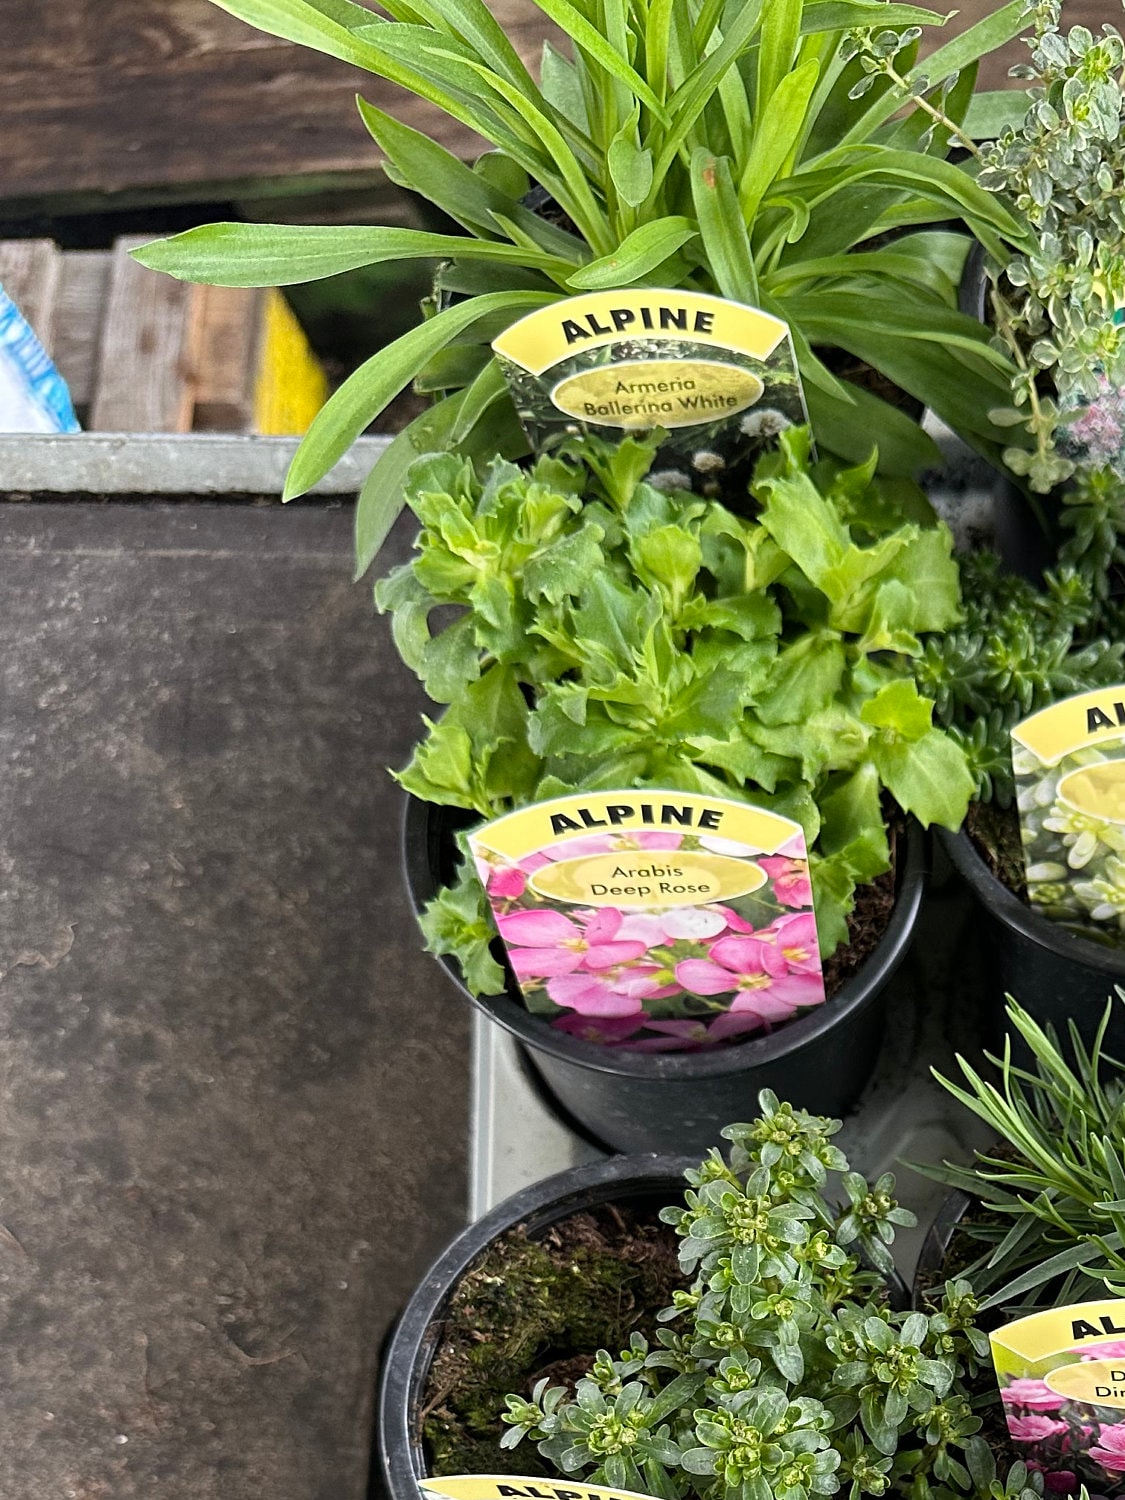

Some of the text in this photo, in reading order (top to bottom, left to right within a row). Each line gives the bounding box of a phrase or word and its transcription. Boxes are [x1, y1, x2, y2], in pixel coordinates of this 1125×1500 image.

[561, 307, 715, 345] ALPINE
[615, 377, 696, 394] Armeria
[584, 395, 738, 417] Ballerina White
[549, 803, 724, 836] ALPINE
[611, 865, 684, 879] Arabis
[591, 881, 711, 897] Deep Rose
